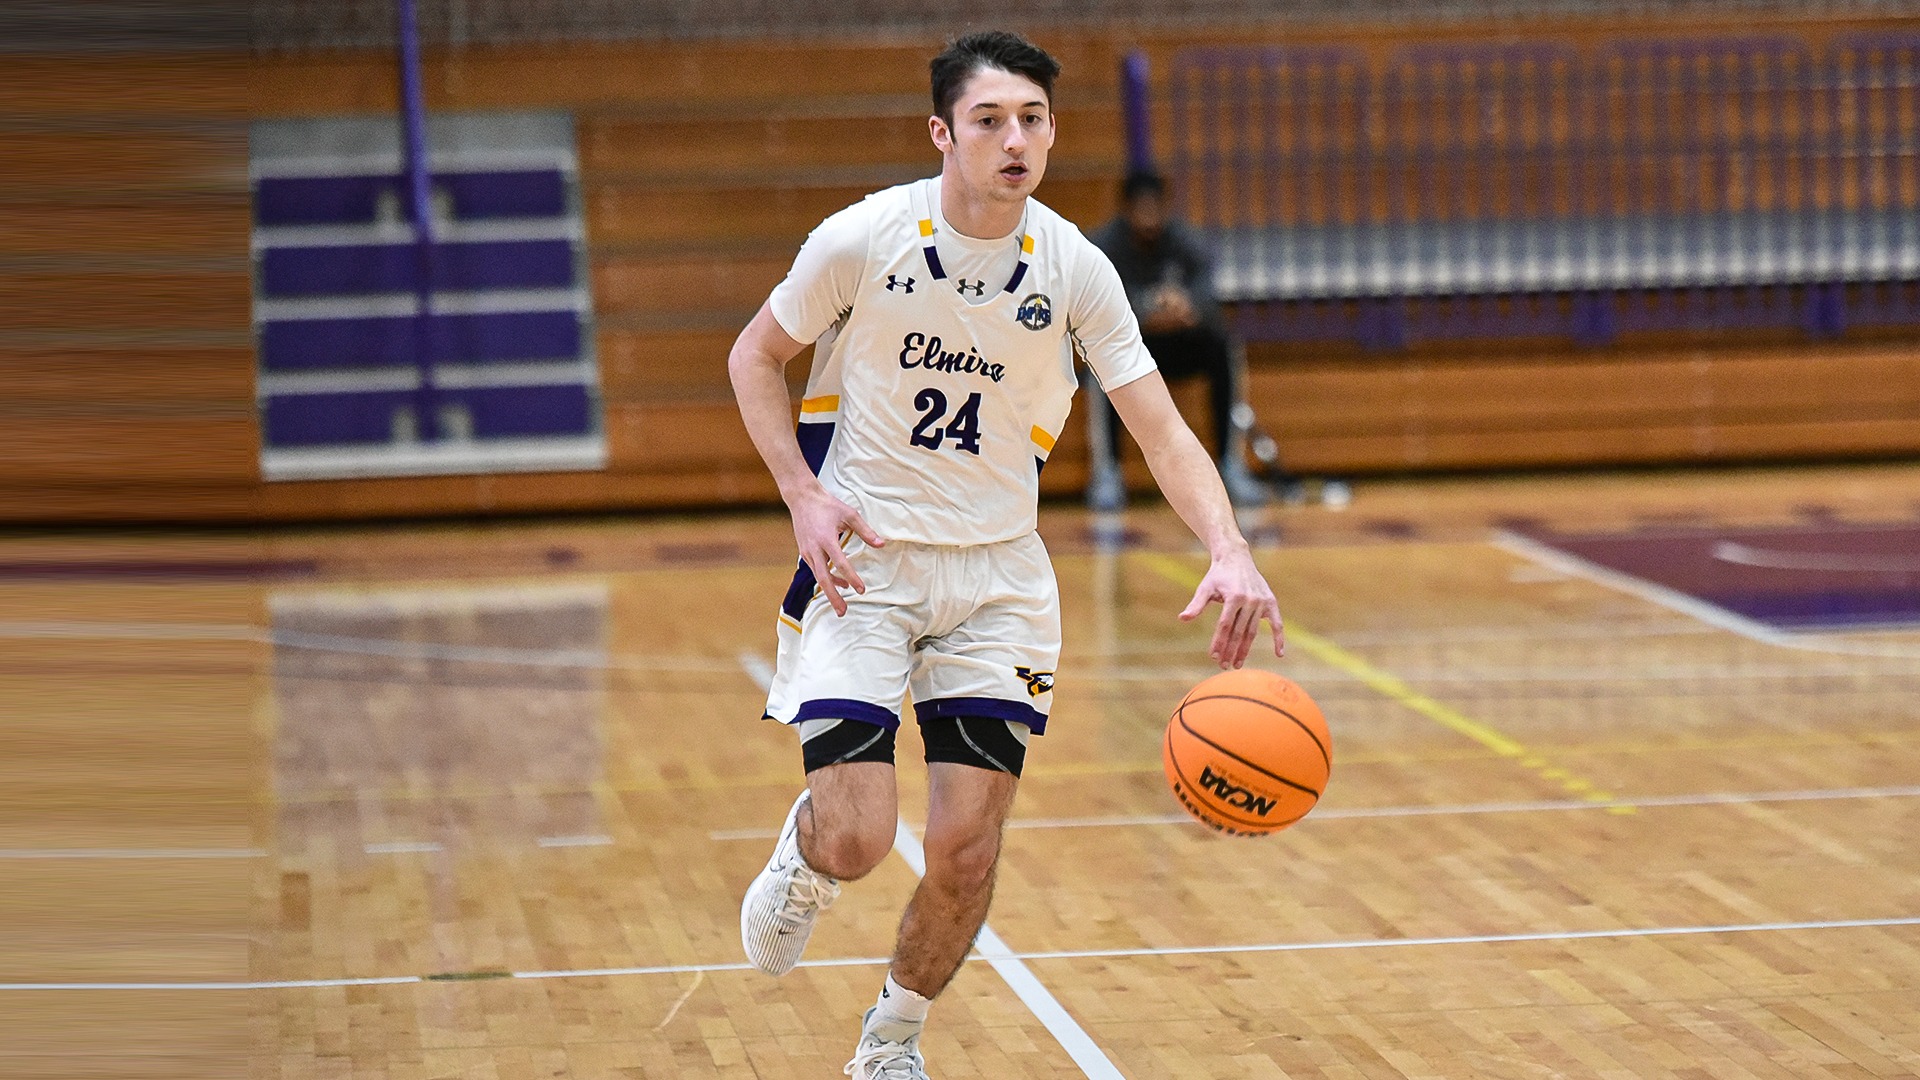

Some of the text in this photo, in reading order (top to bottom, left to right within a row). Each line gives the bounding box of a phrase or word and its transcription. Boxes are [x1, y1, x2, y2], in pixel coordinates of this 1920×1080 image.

[899, 332, 1005, 383] Elmira
[910, 388, 982, 455] 24
[1199, 765, 1277, 817] NCAA
